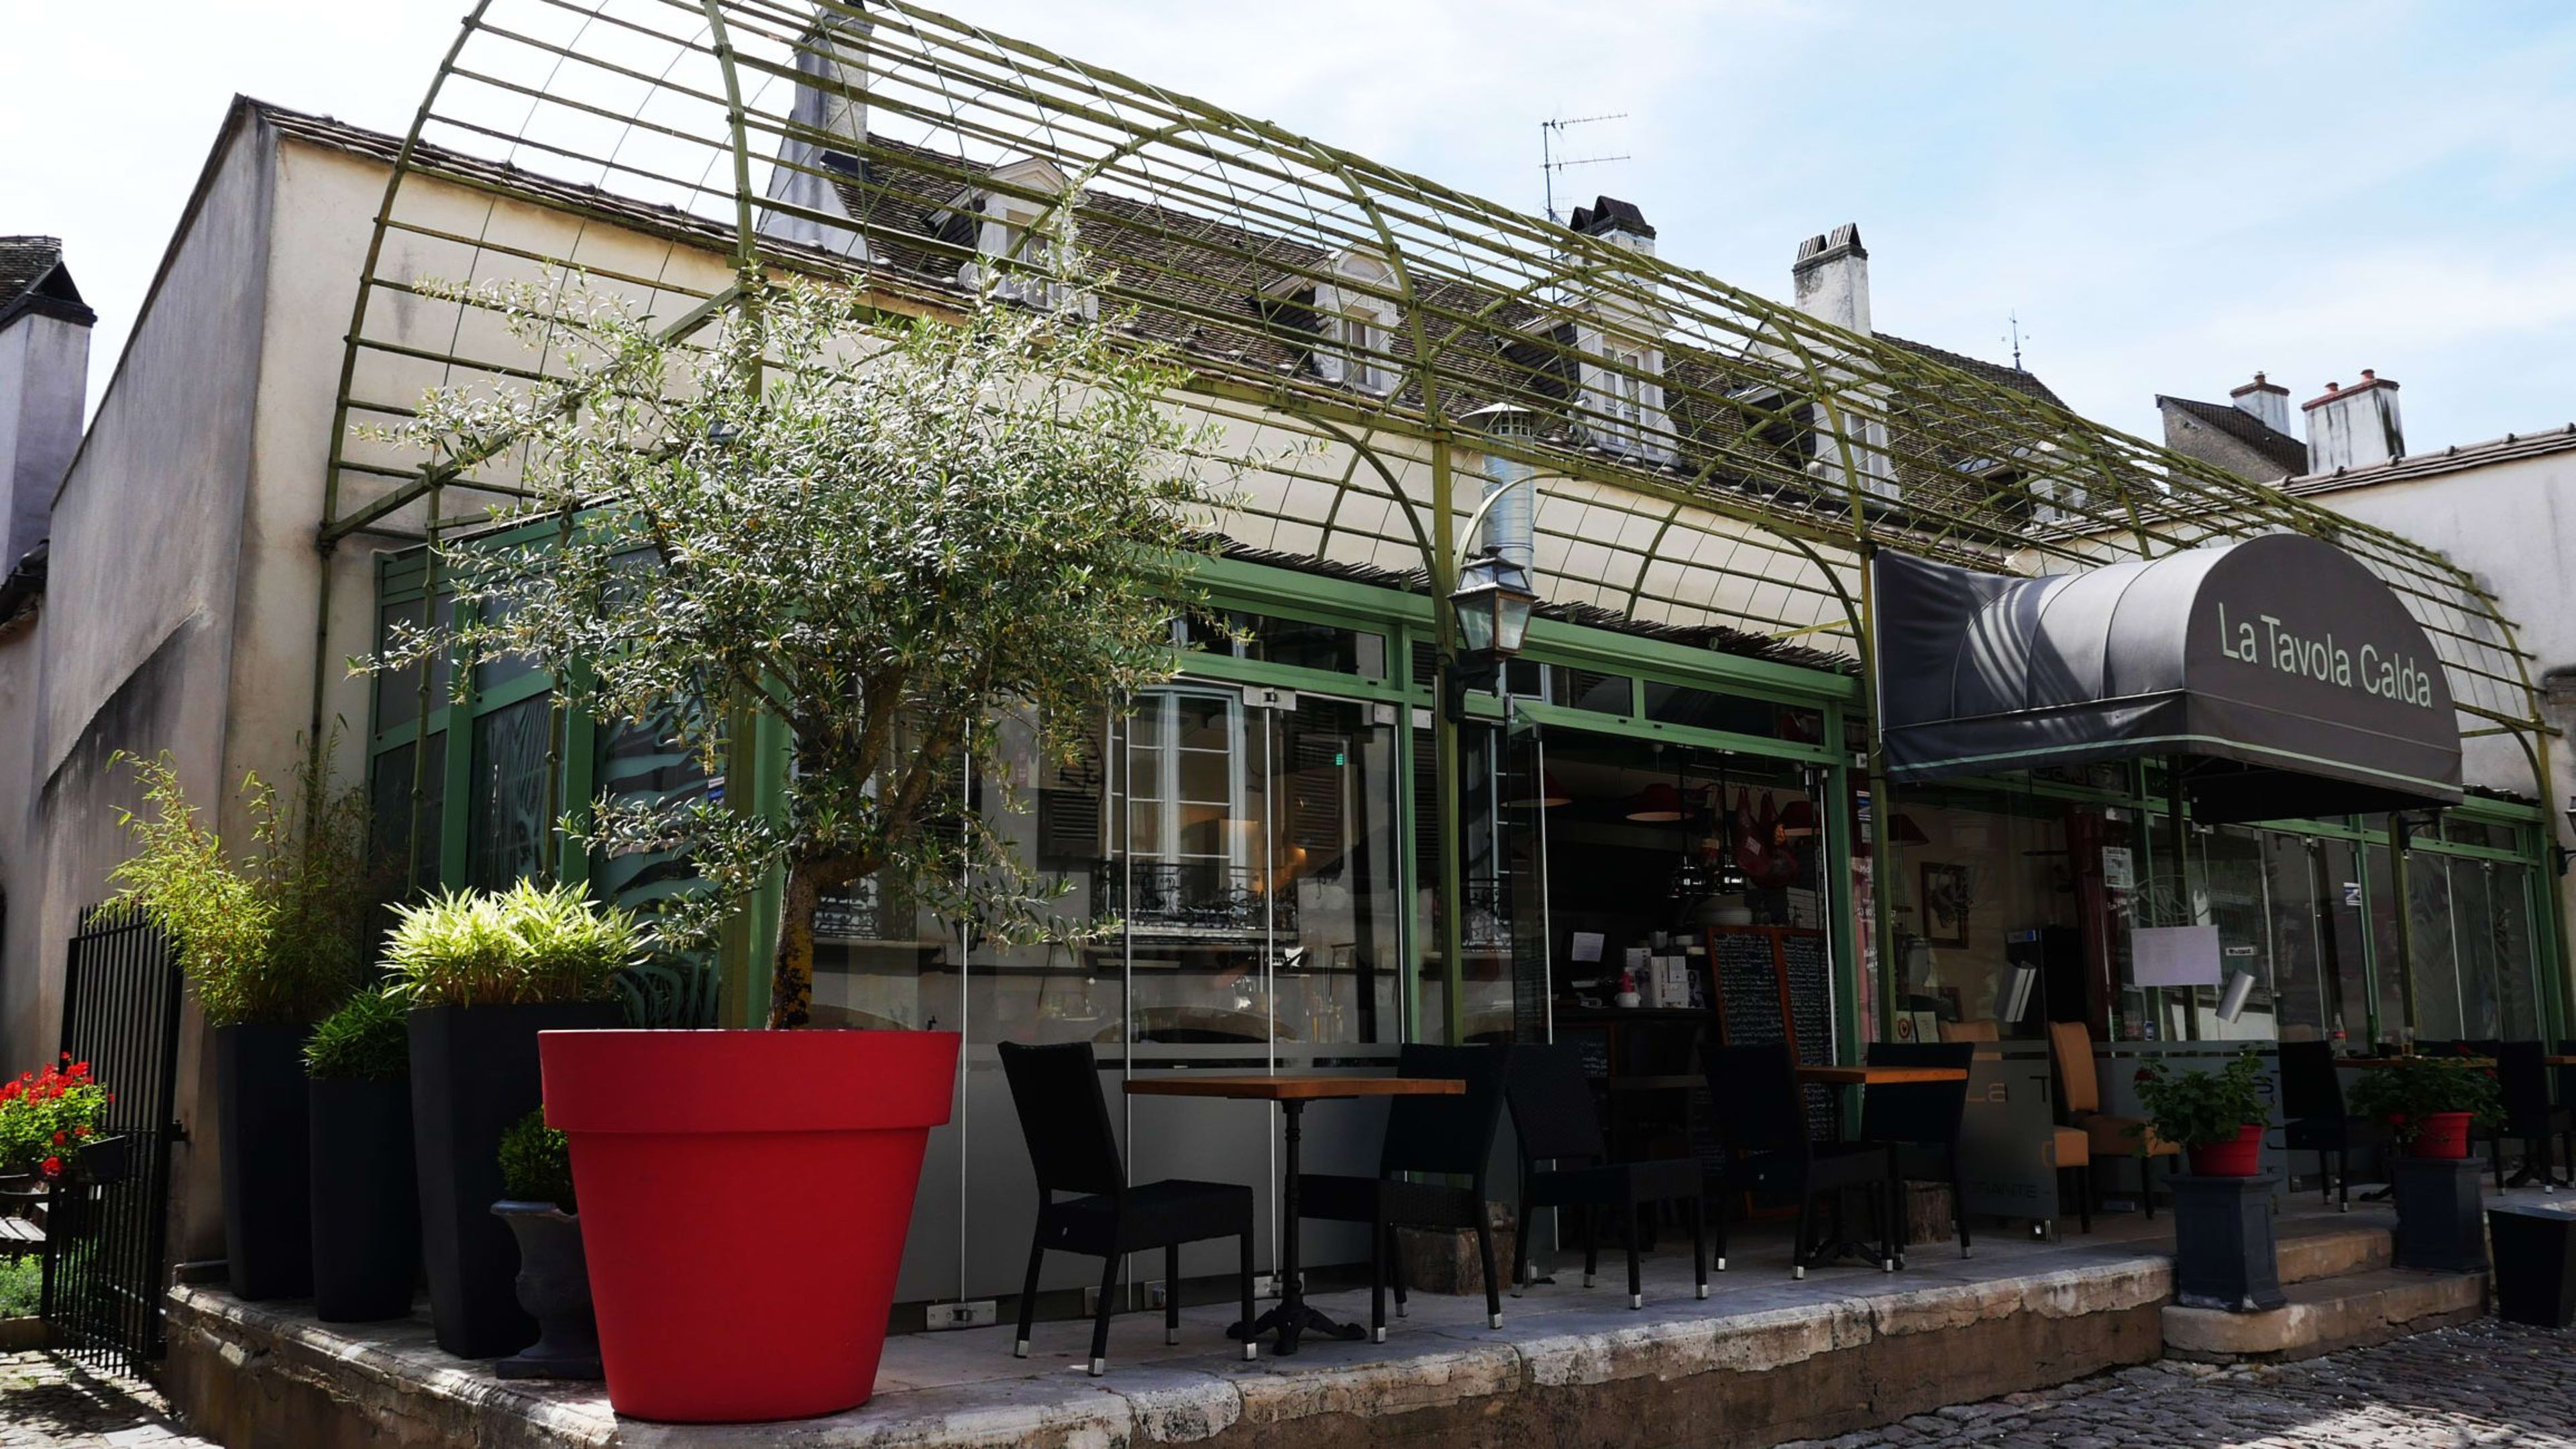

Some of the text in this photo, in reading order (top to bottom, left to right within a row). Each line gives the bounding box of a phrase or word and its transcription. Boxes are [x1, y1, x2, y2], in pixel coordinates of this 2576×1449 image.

[2218, 602, 2432, 708] La Tavola Calda
